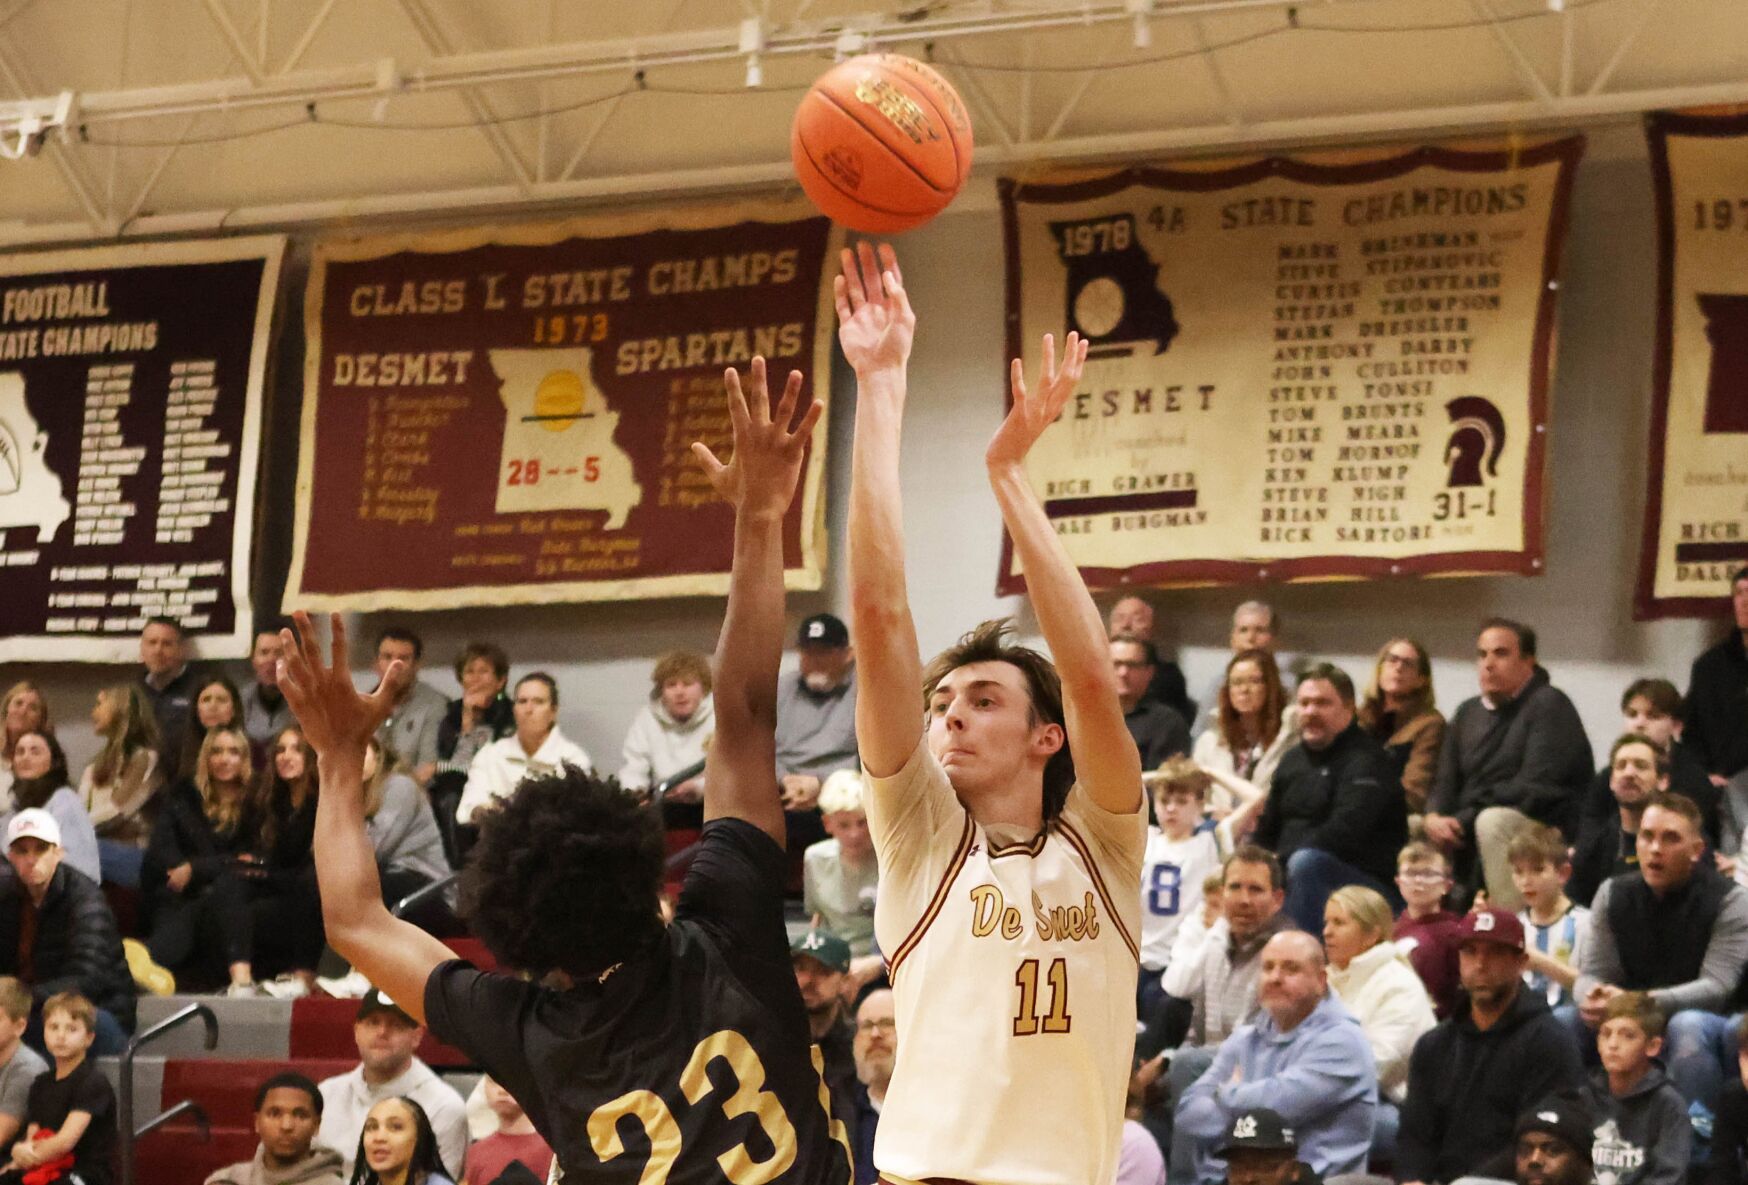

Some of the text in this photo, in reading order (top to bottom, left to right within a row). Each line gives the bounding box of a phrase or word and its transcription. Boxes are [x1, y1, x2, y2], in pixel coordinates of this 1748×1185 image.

[1147, 184, 1528, 231] 4A STATE CHAMPIONS
[1064, 220, 1131, 257] 1978
[350, 249, 799, 318] CLASS L STATE CHAMPS
[2, 281, 110, 325] FOOTBALL
[42, 321, 159, 357] CHAMPIONS
[533, 314, 609, 344] 1973
[1274, 323, 1334, 340] MARK
[616, 323, 803, 376] SPARTANS
[1274, 342, 1375, 361] ANTHONY
[333, 351, 473, 387] DESMET
[1272, 359, 1469, 381] JOHN CULLITON
[1051, 385, 1216, 422] ESMET
[1269, 386, 1338, 402] STEVE
[1269, 407, 1316, 423] TOM
[1267, 424, 1420, 444] MIKE MEARA
[1267, 448, 1314, 463] TOM
[1046, 472, 1195, 497] RICH GRAWER
[1264, 465, 1409, 483] KEN KLUMP
[1262, 488, 1328, 503] STEVE
[1432, 489, 1496, 521] 31-1
[1055, 518, 1092, 535] ALE
[1261, 506, 1401, 523] BRIAN HILL
[1260, 528, 1312, 543] RICK
[1336, 525, 1433, 542] SARTORI
[1681, 522, 1741, 540] RICH
[1149, 864, 1182, 916] 8
[970, 884, 1024, 940] De
[1013, 958, 1072, 1037] 11
[586, 1030, 798, 1185] 23
